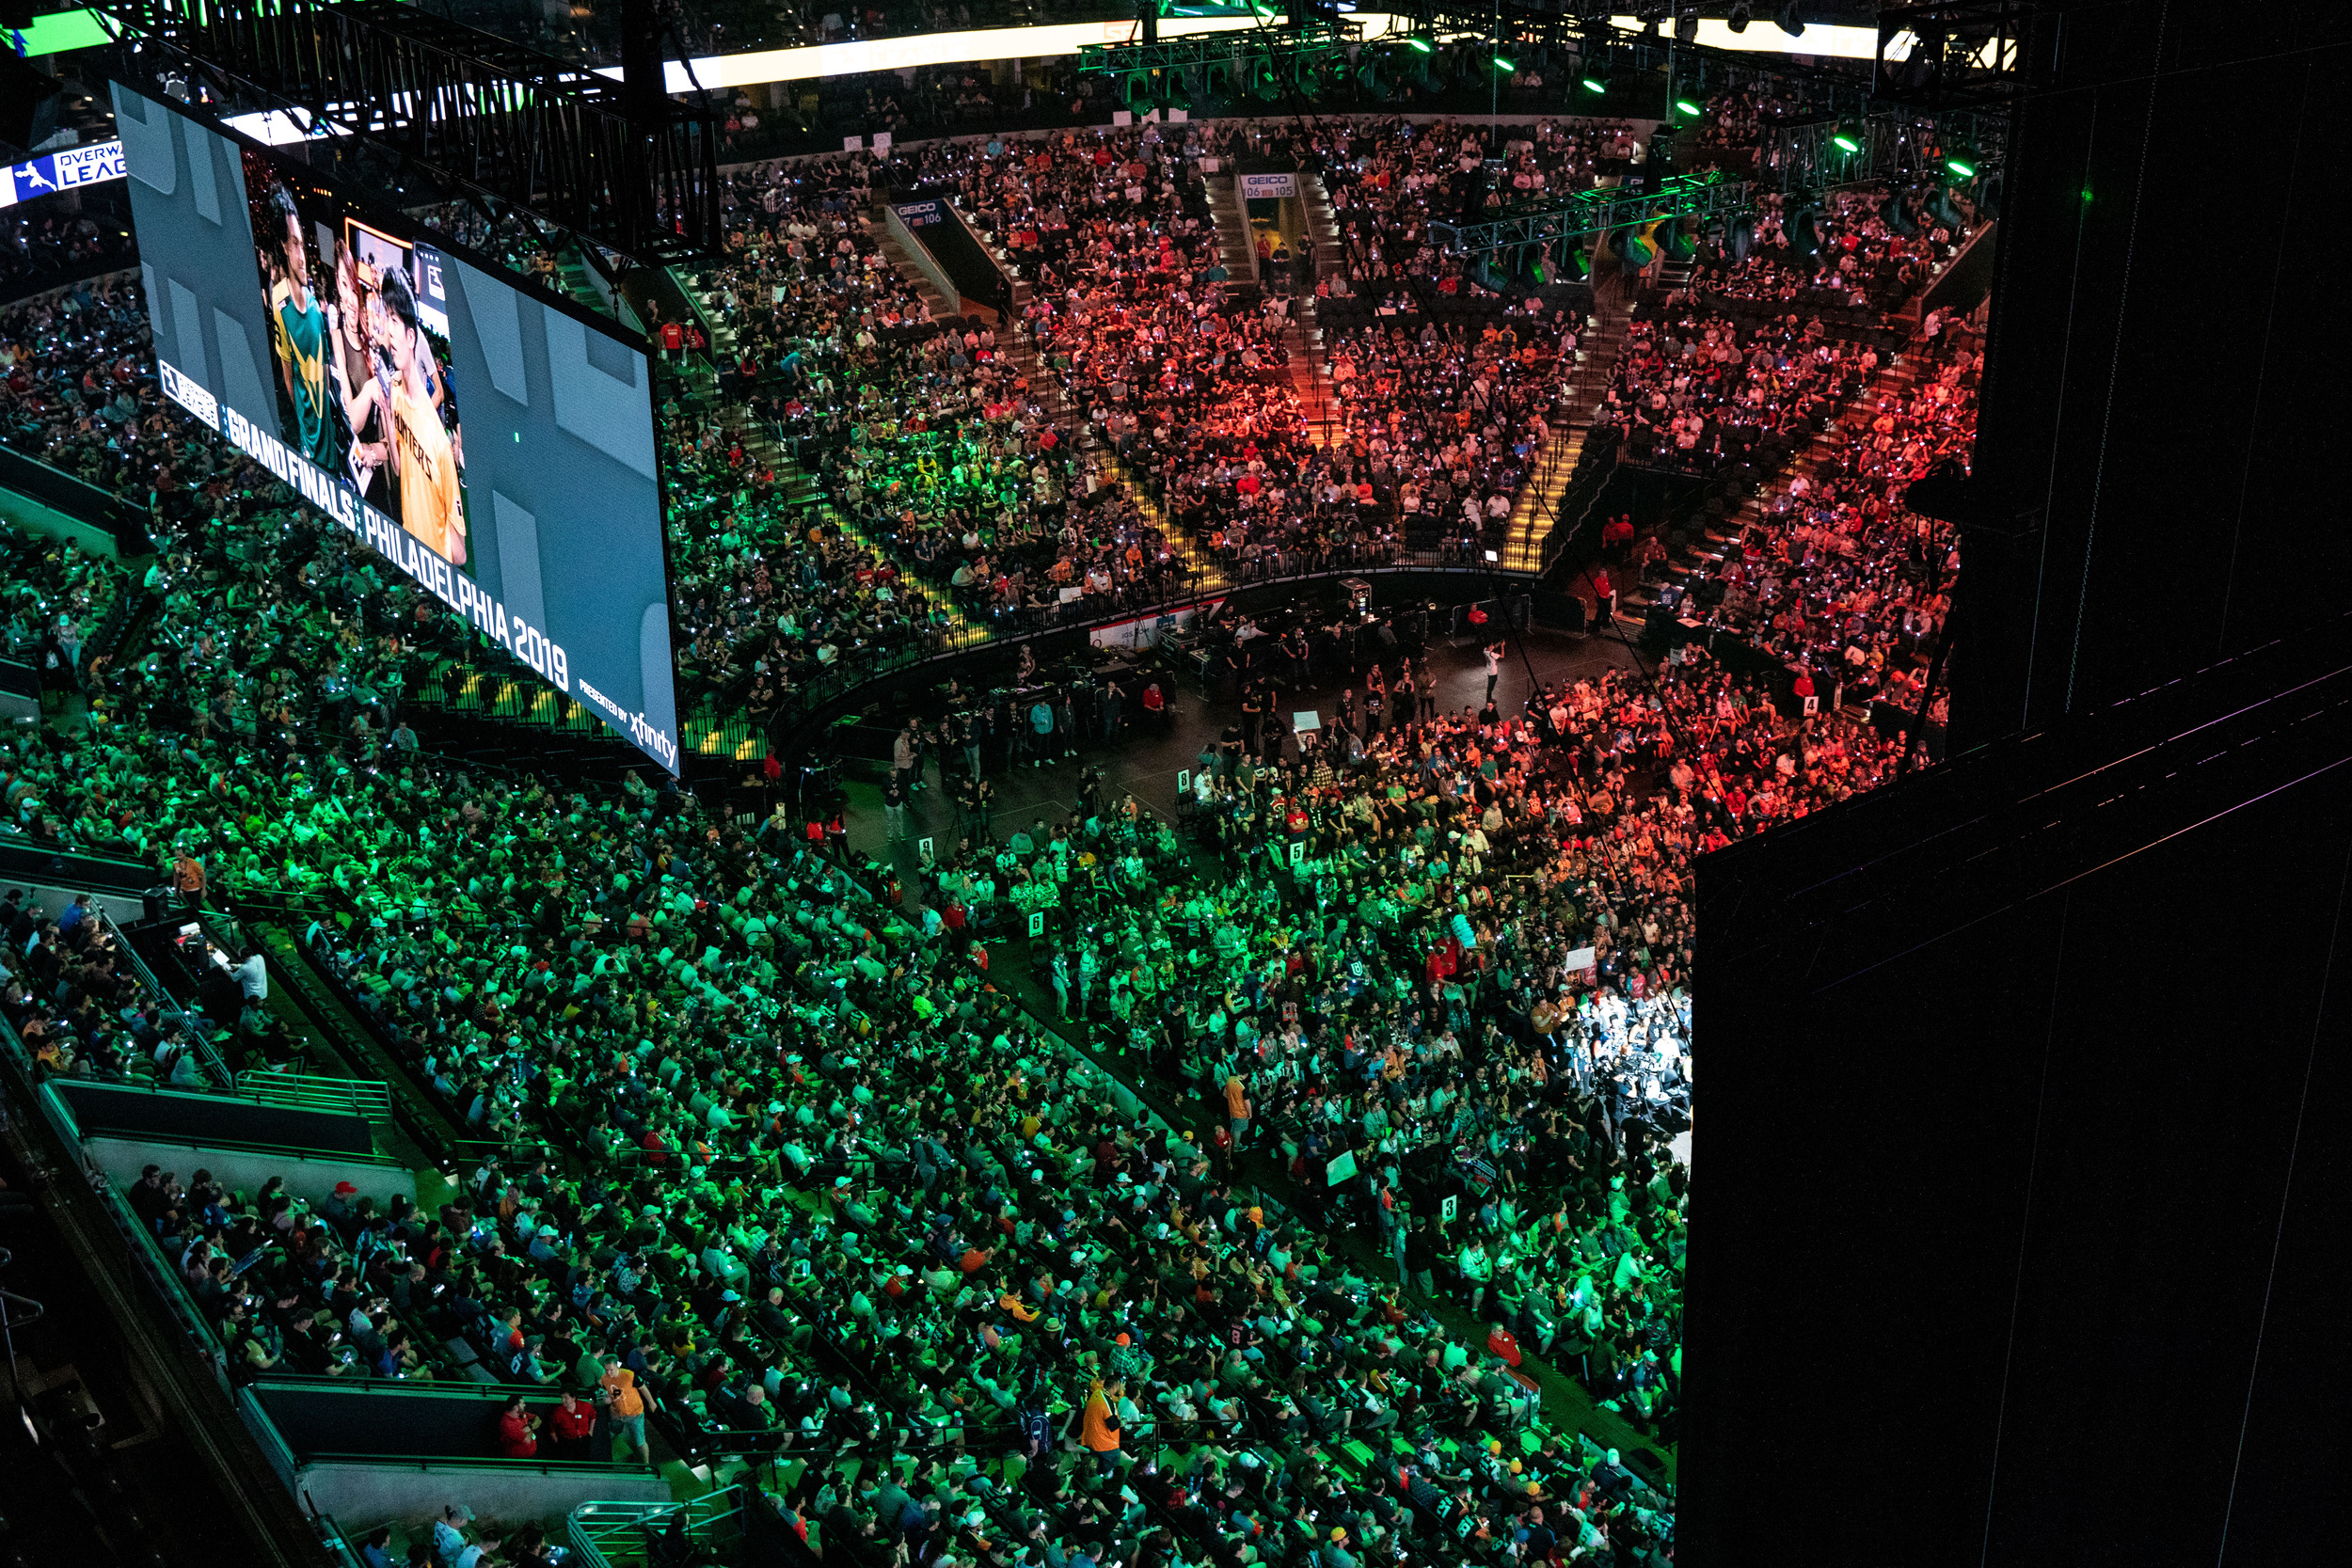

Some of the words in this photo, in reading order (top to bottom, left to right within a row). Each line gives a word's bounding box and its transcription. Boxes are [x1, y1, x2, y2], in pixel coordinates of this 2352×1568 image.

[60, 145, 123, 166] OVERW
[1248, 176, 1288, 185] GEICO
[1275, 186, 1293, 196] 105
[898, 202, 936, 215] GEICO
[925, 213, 942, 224] 106
[227, 406, 288, 482] GRAND
[286, 449, 356, 532] FINALS
[363, 504, 512, 651] PHILADELPHIA
[513, 615, 569, 692] 2019
[1807, 699, 1816, 711] 4
[579, 678, 618, 717] PRESENTED
[617, 706, 628, 723] BY
[628, 711, 677, 768] xfinity
[1181, 772, 1187, 786] 8
[1294, 845, 1301, 860] 5
[1032, 915, 1040, 930] 6
[1445, 1199, 1454, 1217] 3
